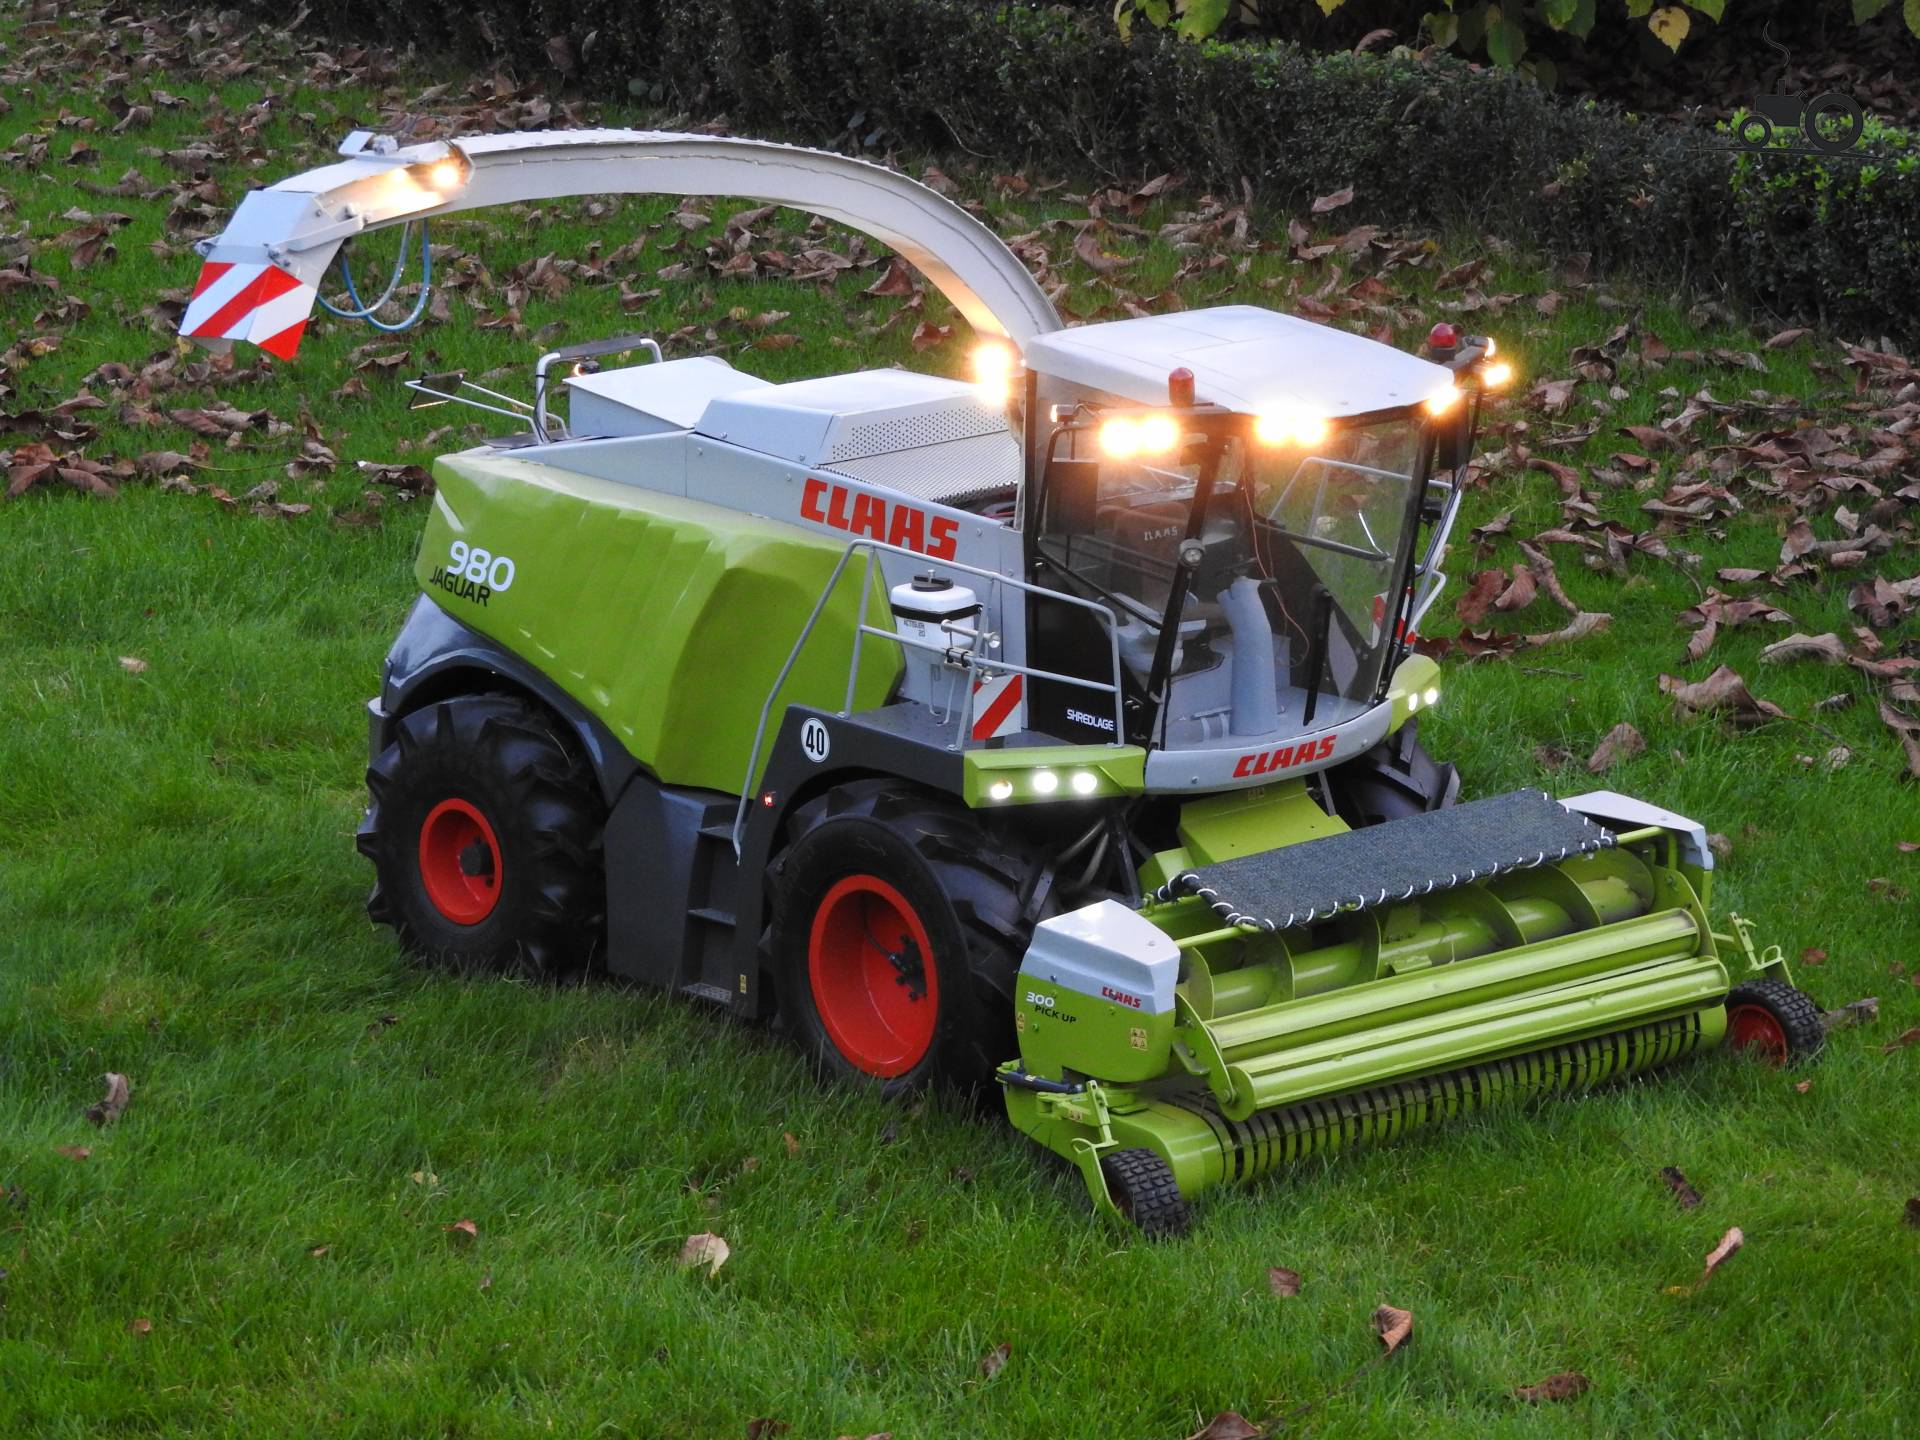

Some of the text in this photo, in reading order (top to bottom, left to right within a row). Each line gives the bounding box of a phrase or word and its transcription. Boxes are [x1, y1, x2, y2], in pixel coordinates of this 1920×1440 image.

[801, 478, 960, 561] CLAAS
[447, 541, 515, 592] 980
[429, 566, 491, 607] JAGUAR
[1066, 708, 1115, 732] SHREDLAGE
[806, 725, 825, 756] 40
[1232, 734, 1338, 778] CLAAS
[1026, 991, 1055, 1008] 300
[1102, 986, 1143, 1009] CLAAS
[1034, 1005, 1077, 1024] PICK UP
